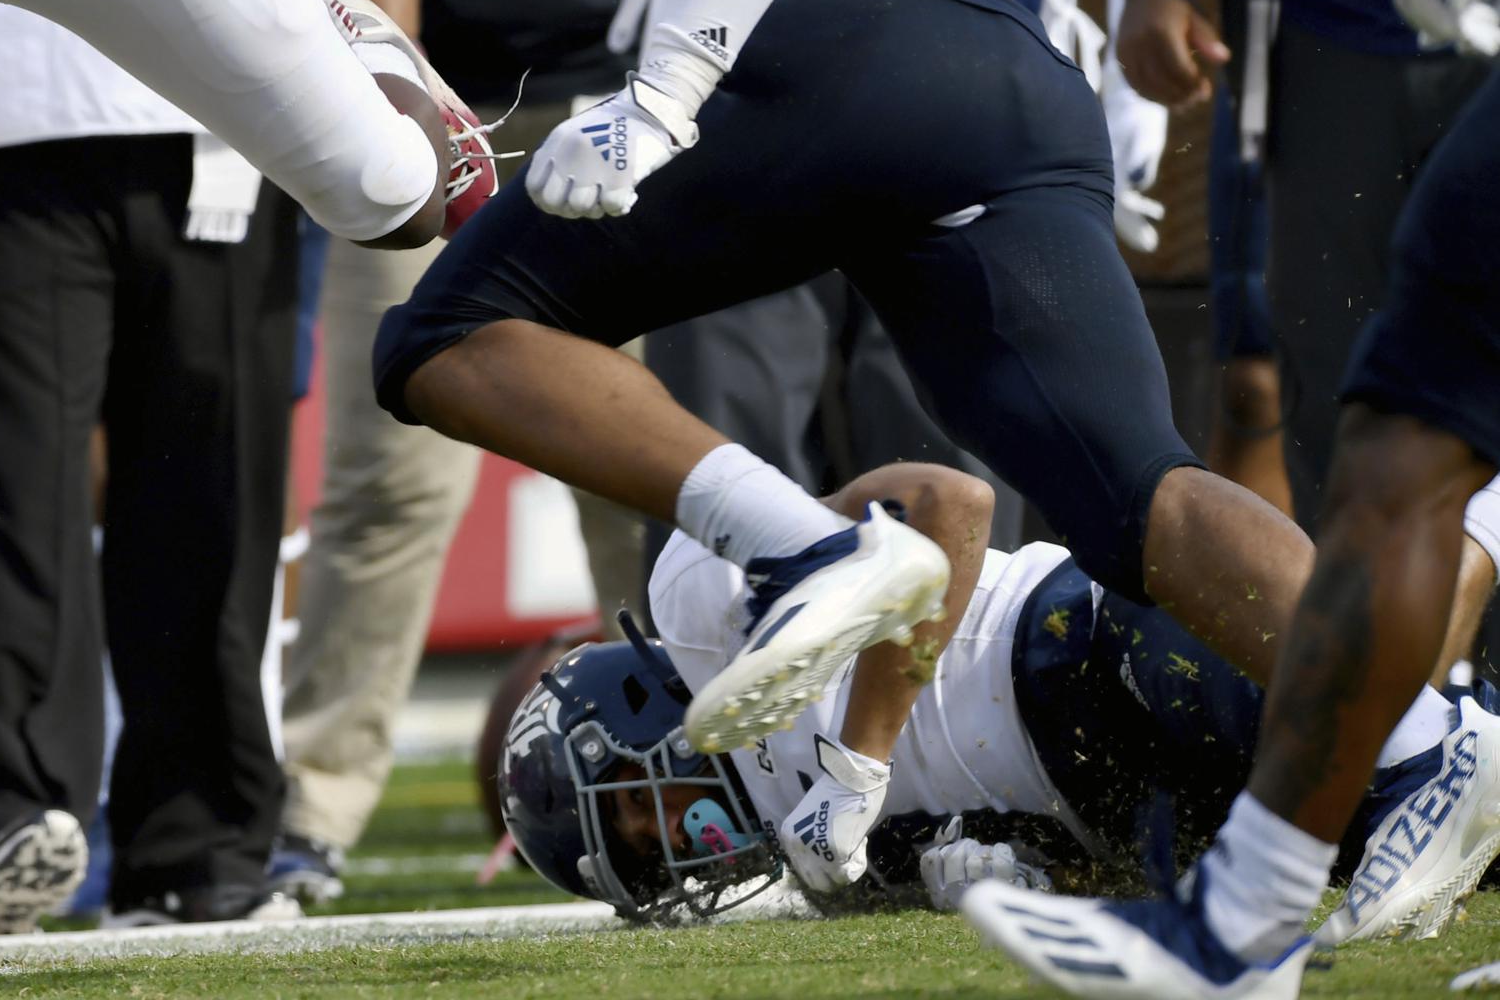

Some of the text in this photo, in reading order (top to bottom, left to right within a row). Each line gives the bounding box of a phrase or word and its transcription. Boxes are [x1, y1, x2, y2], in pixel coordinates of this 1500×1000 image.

[689, 32, 729, 62] adidas
[612, 116, 627, 171] adidas
[816, 800, 835, 862] adidas
[1350, 730, 1477, 926] ADIZERO
